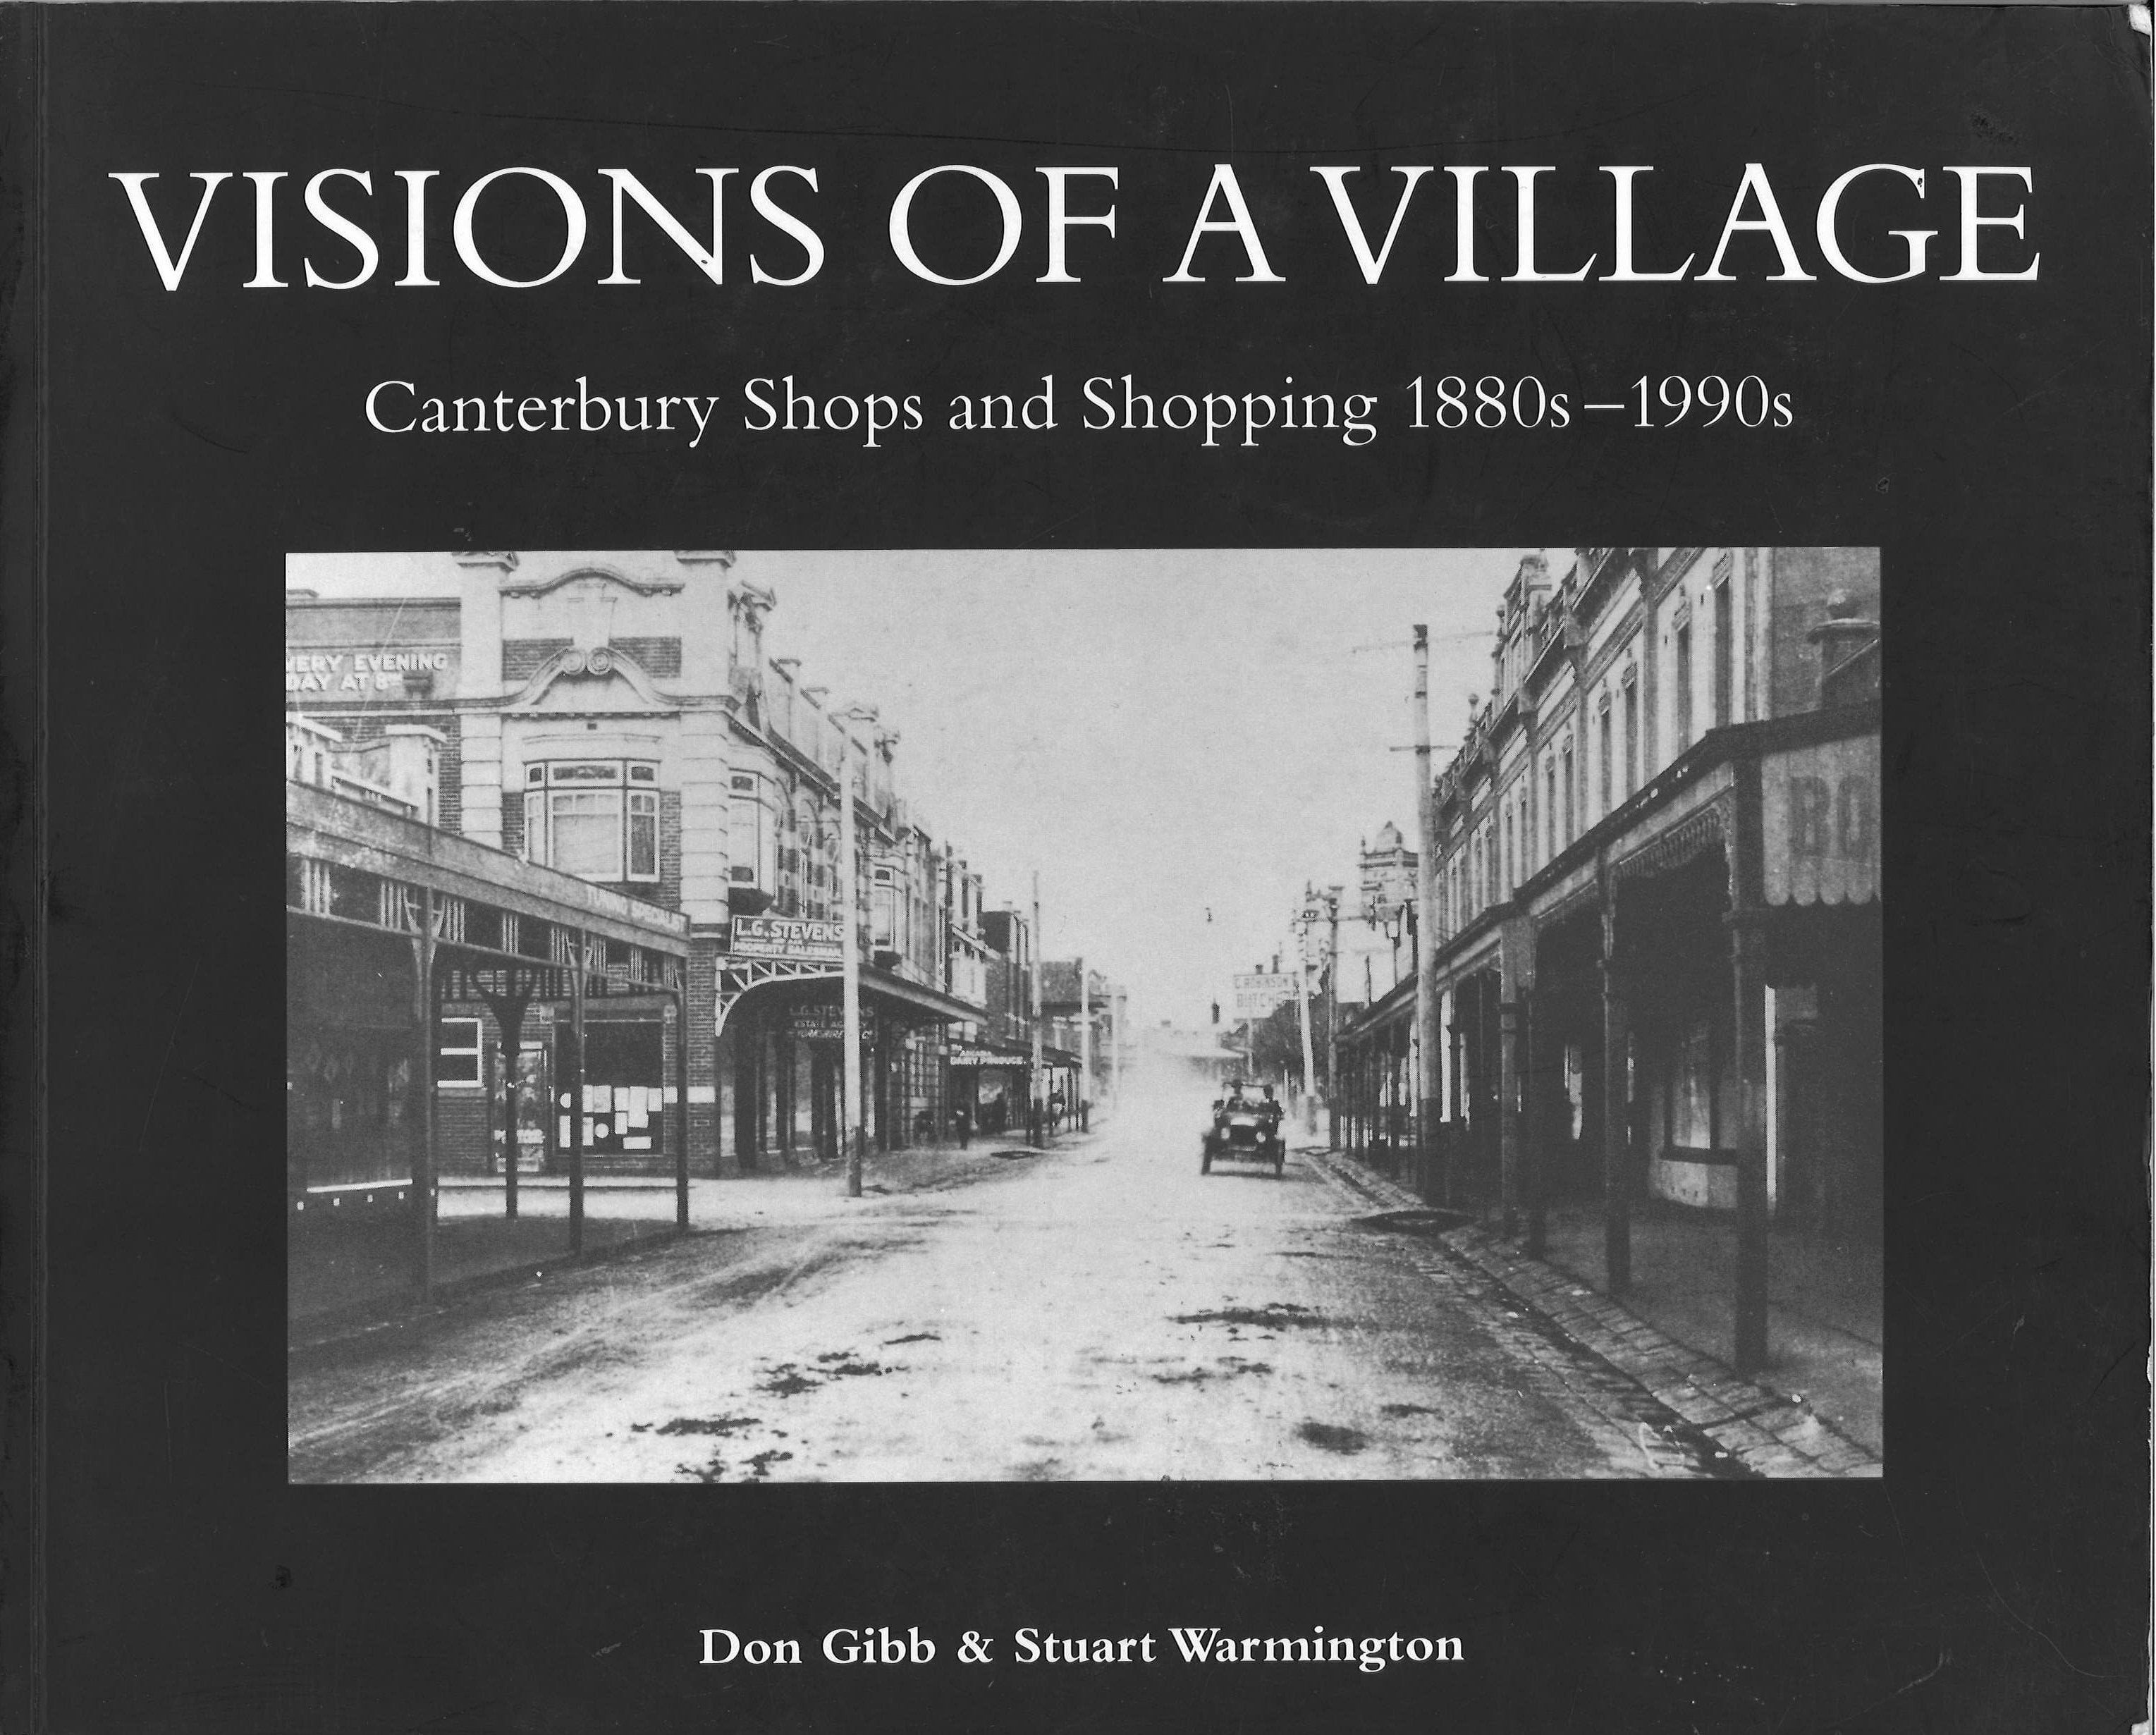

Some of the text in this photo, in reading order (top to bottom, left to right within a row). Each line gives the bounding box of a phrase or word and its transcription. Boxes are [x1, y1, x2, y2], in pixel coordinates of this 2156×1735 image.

[108, 163, 2041, 292] VISIONS OF A VILLAGE
[365, 376, 720, 449] Canterbury
[745, 374, 923, 448] Shops
[949, 374, 1058, 431] and
[1083, 374, 1378, 447] Shopping
[341, 673, 369, 690] AT
[355, 653, 449, 670] EVENING
[699, 1625, 1464, 1673] Don Gibb & Stuart Warmington
